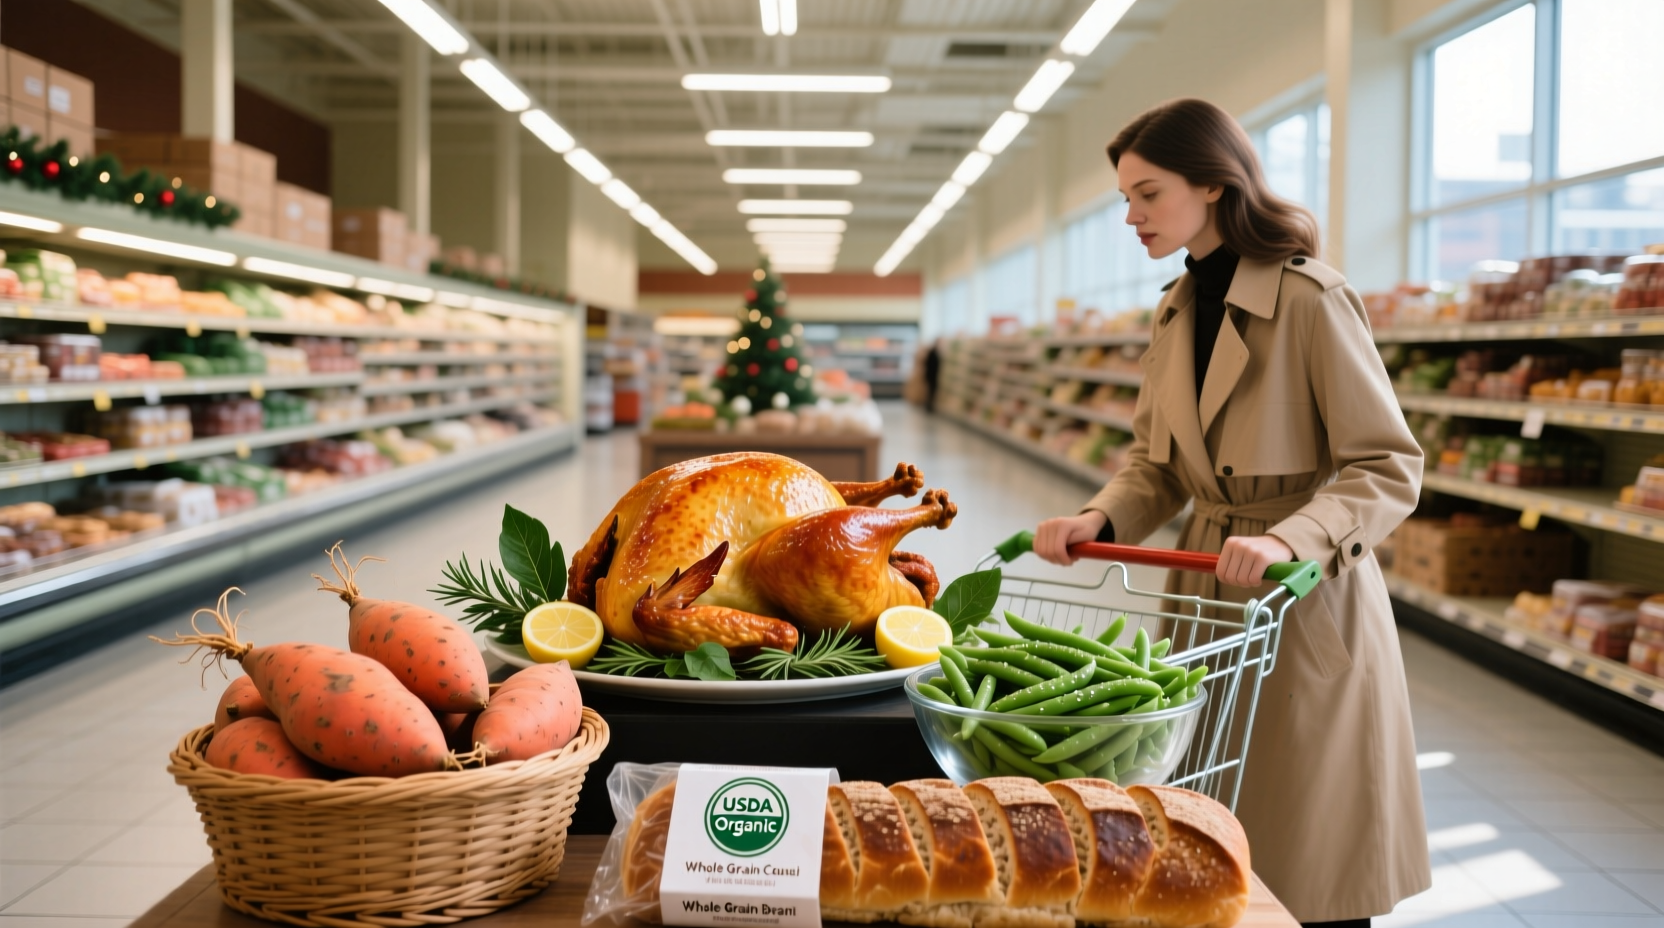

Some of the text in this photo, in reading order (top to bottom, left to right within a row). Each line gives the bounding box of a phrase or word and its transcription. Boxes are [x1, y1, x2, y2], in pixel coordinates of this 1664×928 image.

[723, 797, 773, 813] USDA
[715, 816, 777, 837] Organic
[685, 861, 723, 873] Whole
[726, 863, 760, 875] Grain
[724, 902, 758, 915] Grain
